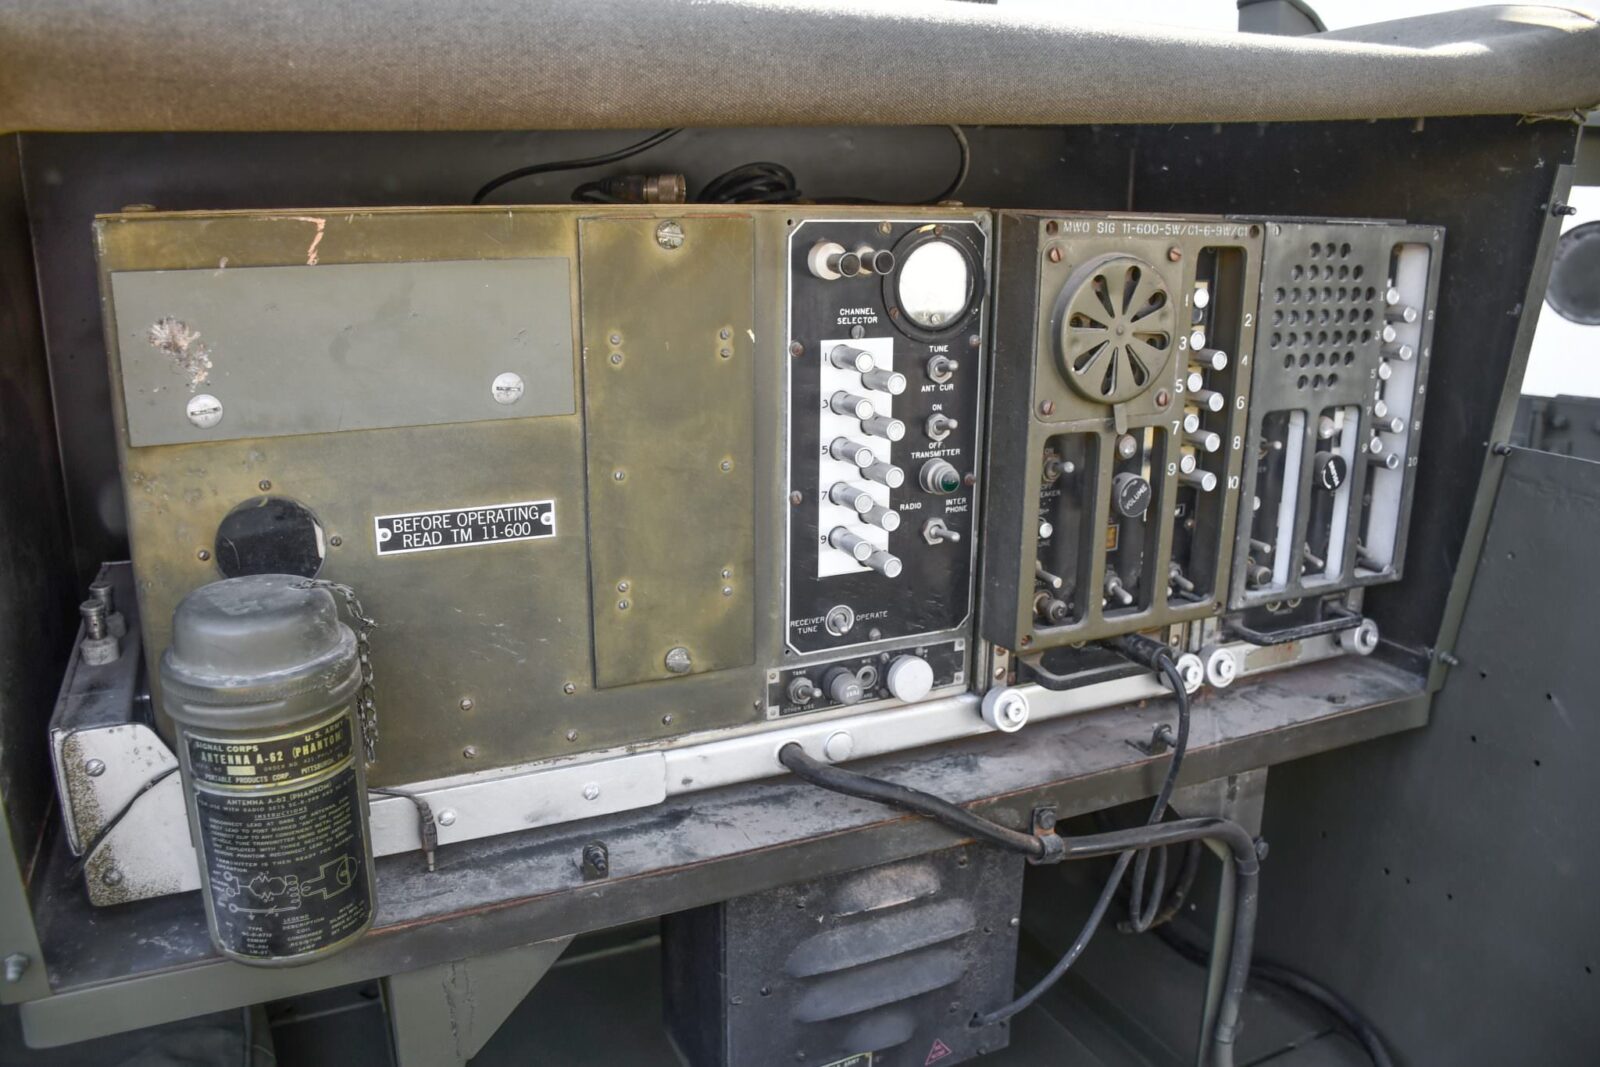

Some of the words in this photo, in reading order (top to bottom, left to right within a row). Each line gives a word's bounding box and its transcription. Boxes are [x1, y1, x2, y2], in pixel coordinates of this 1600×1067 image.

[1063, 222, 1090, 233] MWO
[1097, 222, 1115, 234] SIG
[840, 308, 876, 316] CHANNEL
[837, 316, 878, 325] SELECTOR
[1244, 314, 1252, 326] 2
[1179, 336, 1187, 350] 3
[929, 345, 949, 353] TUNE
[1241, 355, 1248, 365] 4
[921, 384, 935, 392] ANT
[1176, 379, 1183, 392] 5
[822, 400, 829, 408] 3
[1236, 397, 1245, 409] 6
[1172, 420, 1180, 435] 7
[929, 441, 942, 449] OFF
[1232, 436, 1241, 449] 8
[822, 446, 828, 454] 5
[911, 448, 960, 459] TRANSMITTER
[1408, 456, 1418, 467] 10
[1168, 463, 1176, 476] 9
[1228, 476, 1239, 489] 10
[821, 491, 828, 500] 7
[1124, 483, 1147, 510] VOLUME
[900, 502, 922, 511] RADIO
[946, 497, 967, 506] INTER
[945, 505, 968, 513] PHONE
[392, 514, 451, 534] BEFORE
[456, 506, 539, 527] OPERATING
[402, 531, 442, 548] READ
[450, 529, 473, 543] TM
[482, 522, 531, 540] 11-600
[820, 535, 826, 544] 9
[856, 610, 888, 621] OPERATE
[790, 616, 825, 627] RECEIVER
[797, 625, 818, 634] TUNE
[195, 742, 223, 752] SIGNAL
[201, 752, 251, 764] ANTENNA
[256, 751, 283, 764] A-62
[236, 775, 268, 784] PRODUCTS
